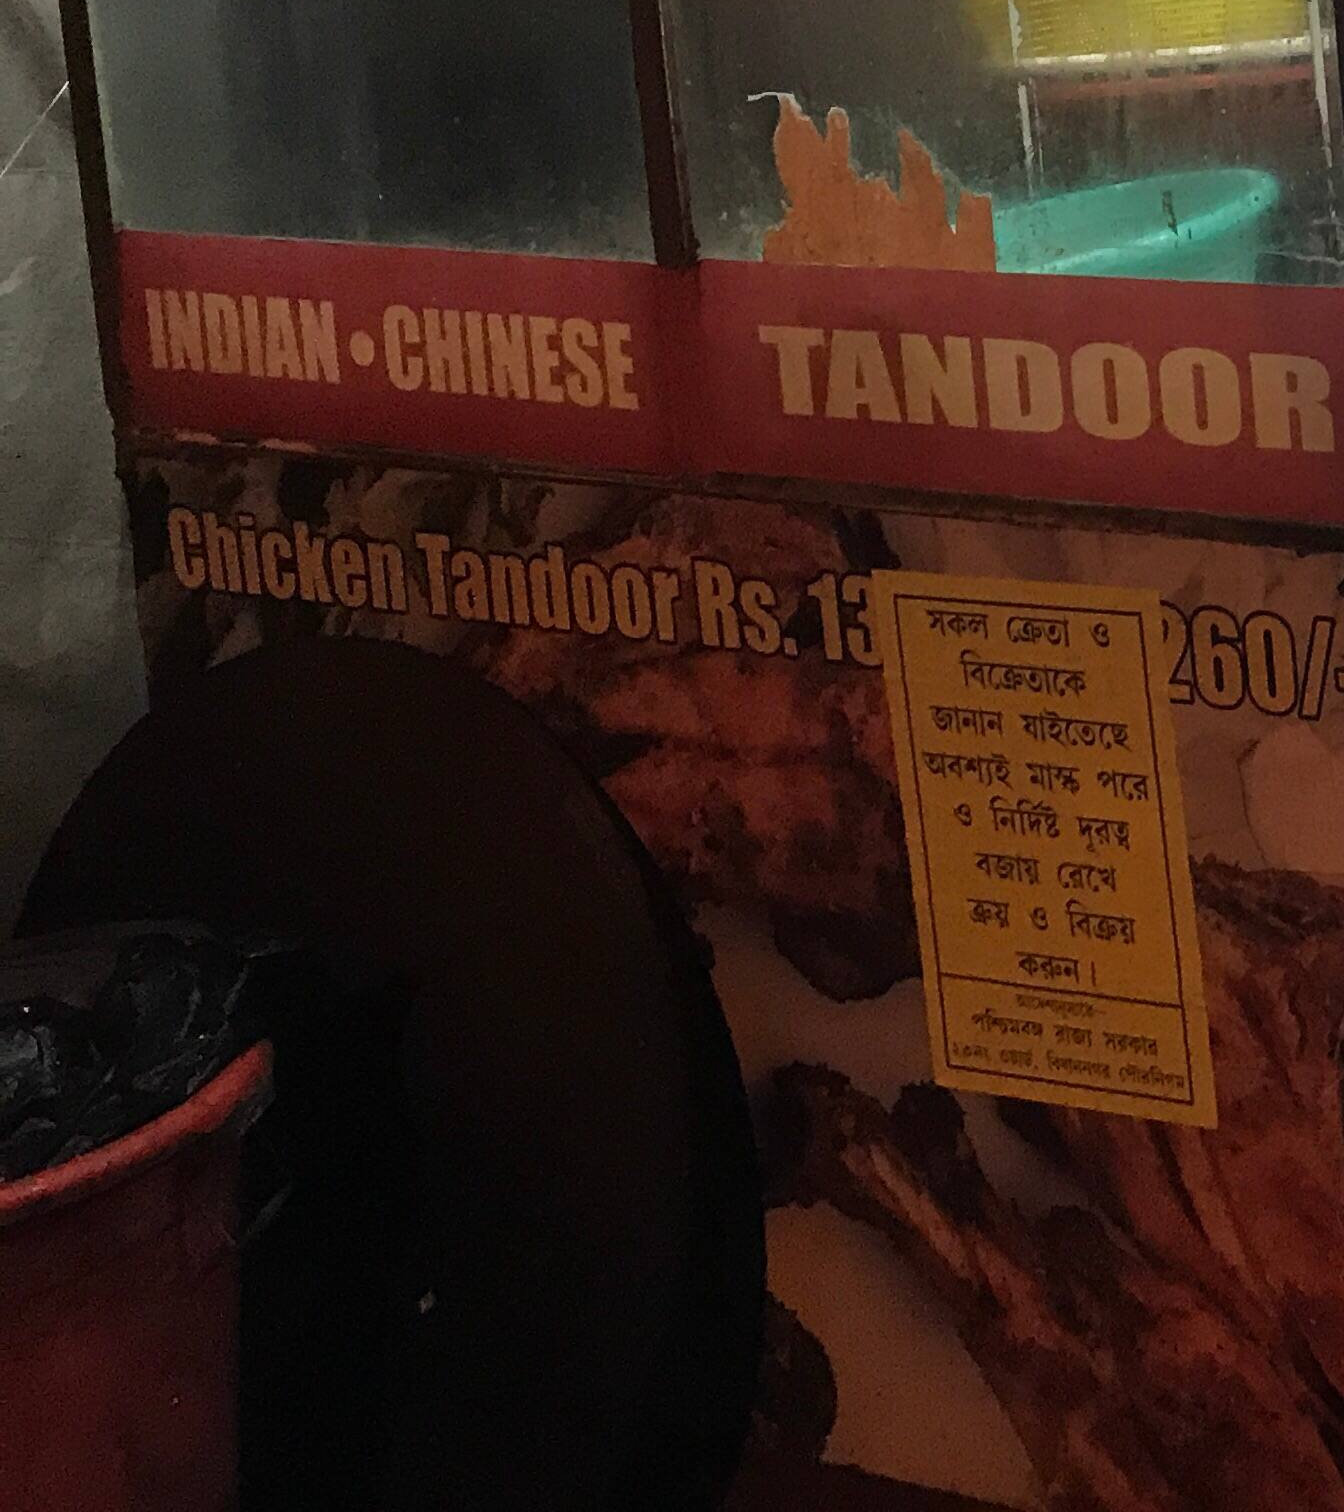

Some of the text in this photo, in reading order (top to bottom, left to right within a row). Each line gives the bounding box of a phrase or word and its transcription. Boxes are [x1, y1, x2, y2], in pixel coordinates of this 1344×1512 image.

[145, 288, 639, 409] INDIAN CHINESE
[760, 323, 1337, 453] TANDOOR
[167, 506, 408, 613] Chicken
[414, 531, 681, 644] Tandoor
[692, 554, 799, 658] Rs.
[925, 609, 1111, 648] সকল ক্রেতা ও
[959, 648, 1087, 698] বিক্রেতাকে
[929, 706, 1132, 752] জানান যাইতেছে
[922, 751, 1013, 789] অবশ্যই
[1097, 769, 1149, 801] পরে
[953, 803, 973, 827] ও
[1057, 861, 1116, 893] রেখে
[1030, 907, 1048, 931] ও
